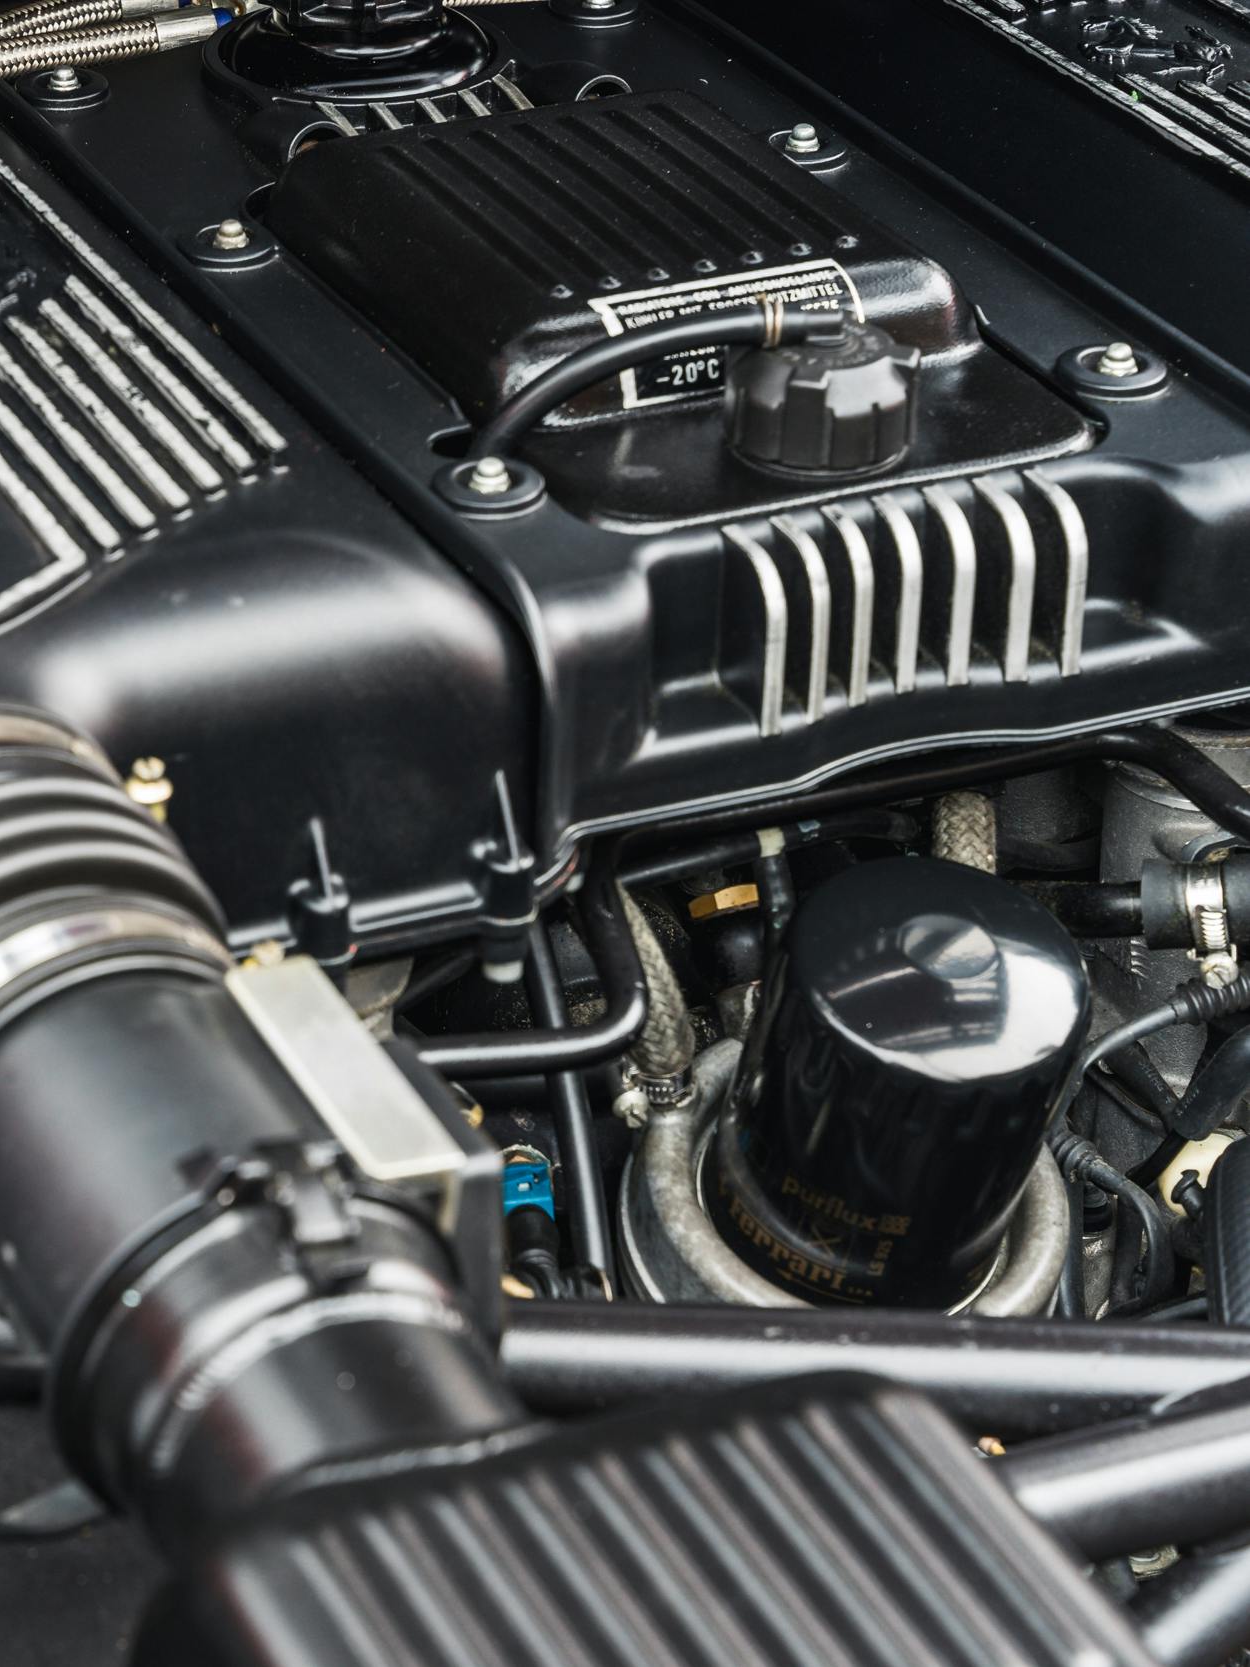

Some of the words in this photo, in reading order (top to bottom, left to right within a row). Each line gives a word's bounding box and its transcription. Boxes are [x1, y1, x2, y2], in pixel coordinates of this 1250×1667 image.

[692, 288, 722, 302] CON
[656, 357, 720, 385] -20°C
[781, 1175, 876, 1231] purflux
[729, 1195, 847, 1291] Ferrari
